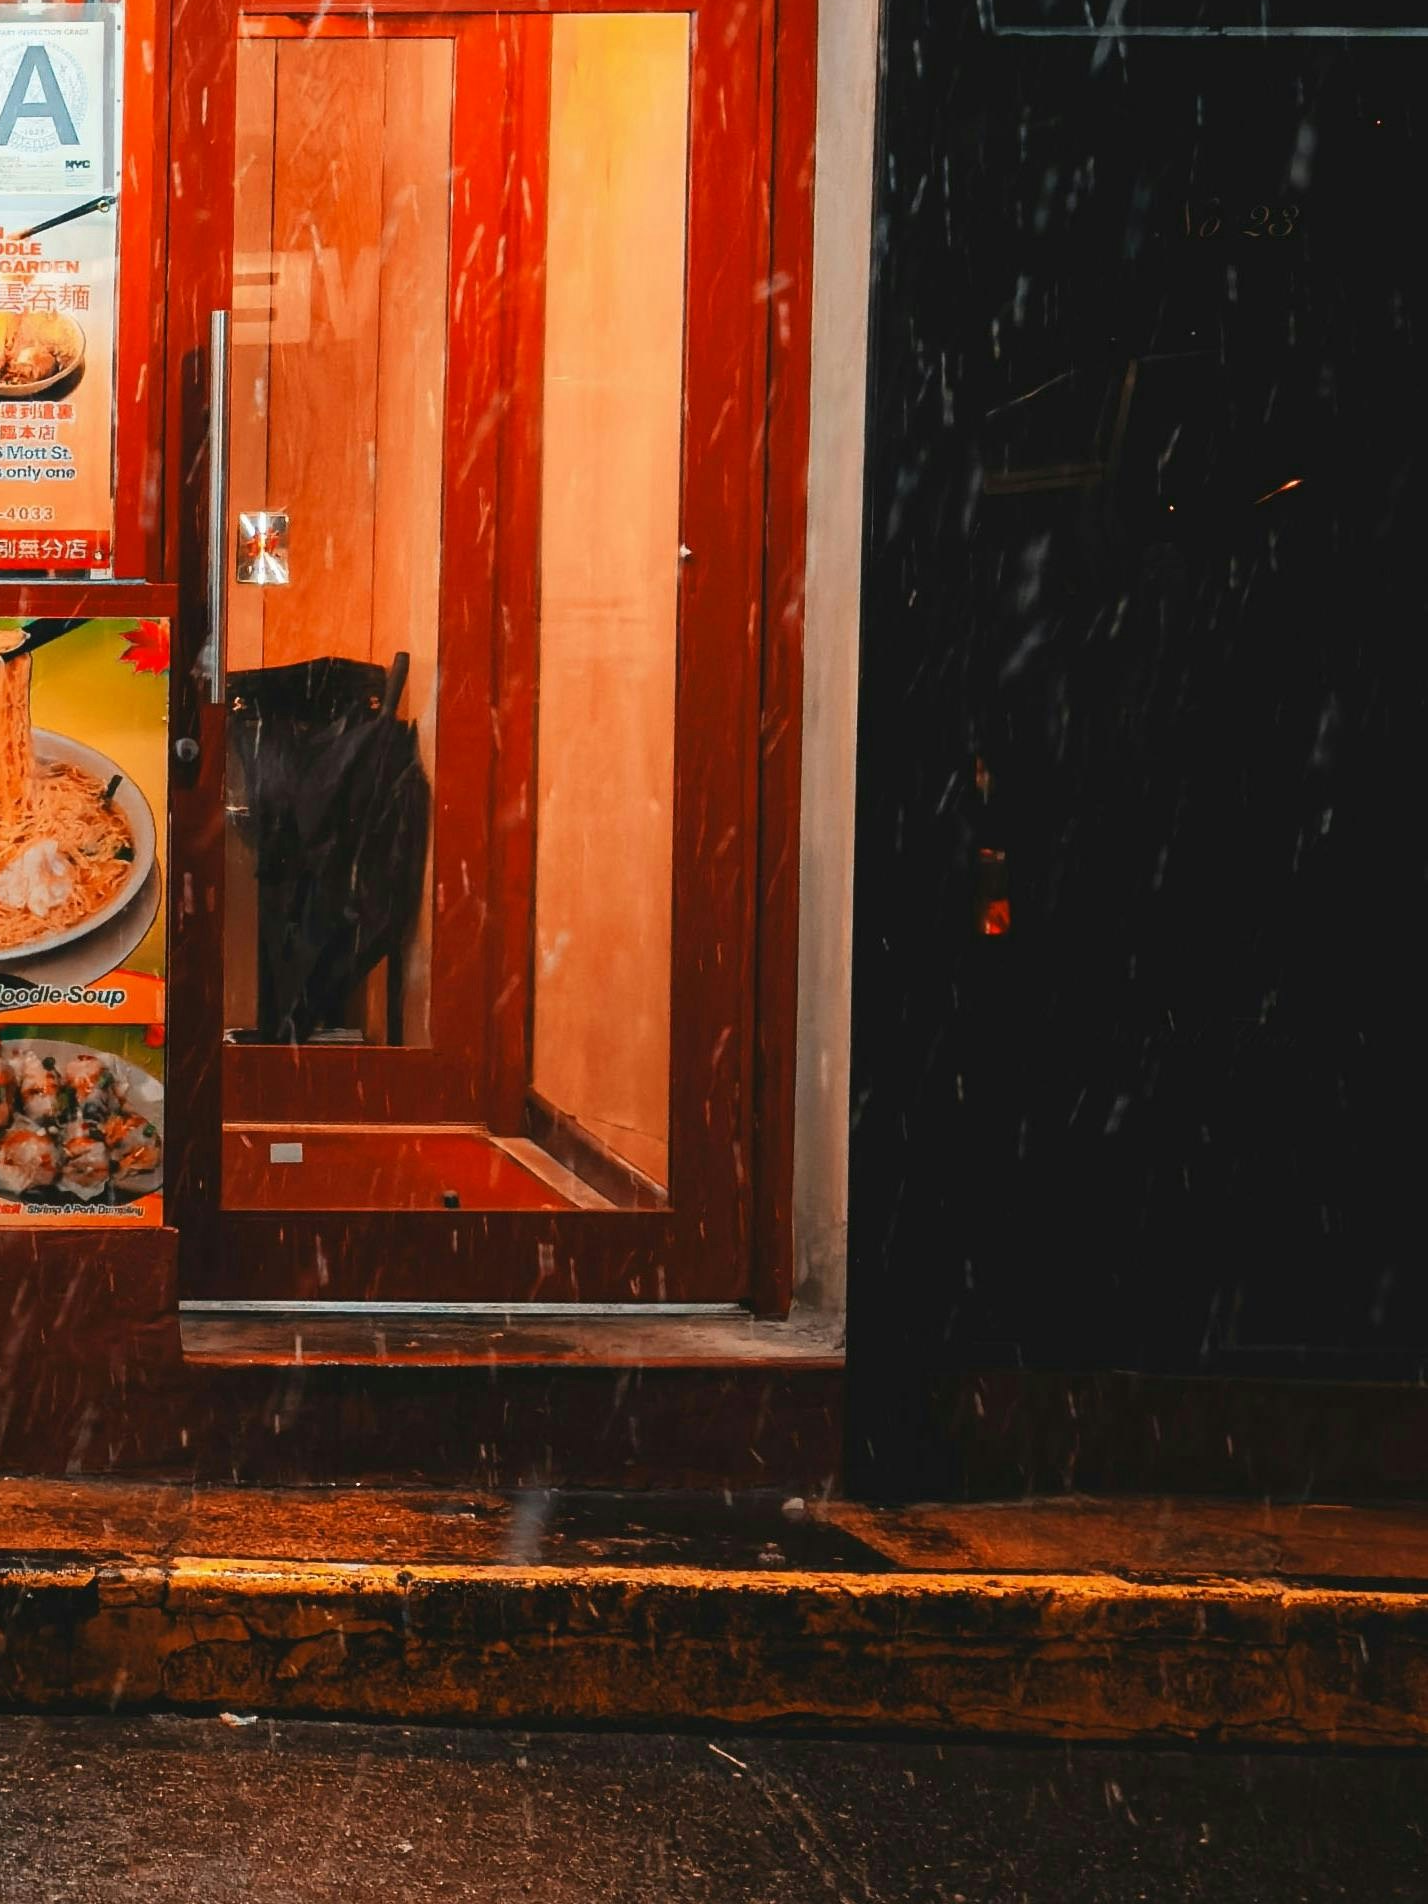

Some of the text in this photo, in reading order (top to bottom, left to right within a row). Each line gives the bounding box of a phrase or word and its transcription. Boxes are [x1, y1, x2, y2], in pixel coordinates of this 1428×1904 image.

[65, 160, 90, 168] NYC
[7, 447, 47, 459] Mott
[6, 466, 40, 482] only
[46, 470, 75, 478] one
[68, 986, 125, 1008] Soup
[27, 1205, 62, 1215] Shrimp
[73, 1205, 95, 1214] Pork
